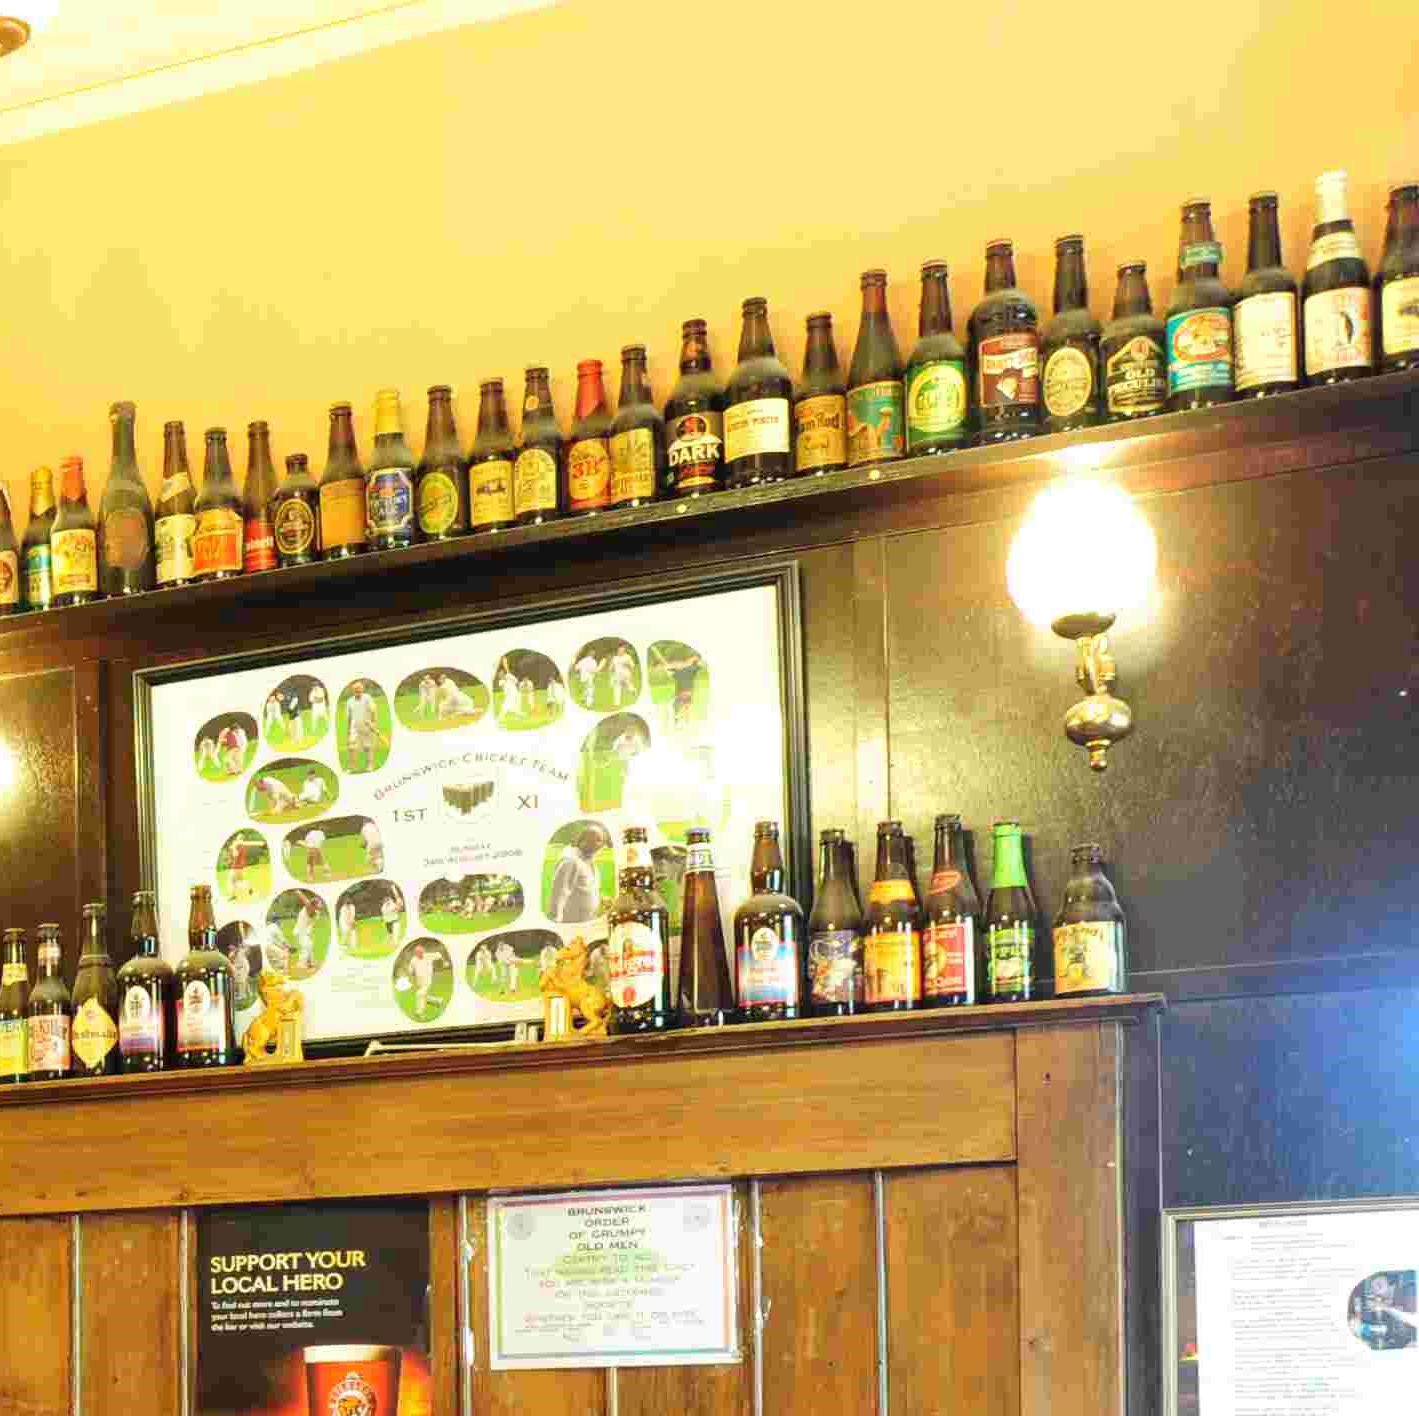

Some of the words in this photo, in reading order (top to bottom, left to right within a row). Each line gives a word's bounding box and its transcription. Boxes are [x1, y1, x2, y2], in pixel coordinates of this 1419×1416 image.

[668, 443, 720, 466] DARK
[567, 1204, 647, 1217] BRUNSWICK
[584, 1216, 630, 1228] ORDER
[591, 1228, 647, 1240] GRUMPY
[576, 1242, 604, 1251] OLD
[609, 1240, 639, 1250] MEN
[210, 1252, 303, 1273] SUPPORT
[305, 1250, 367, 1269] YOUR
[210, 1275, 279, 1294] LOCAL
[282, 1272, 344, 1292] HERO
